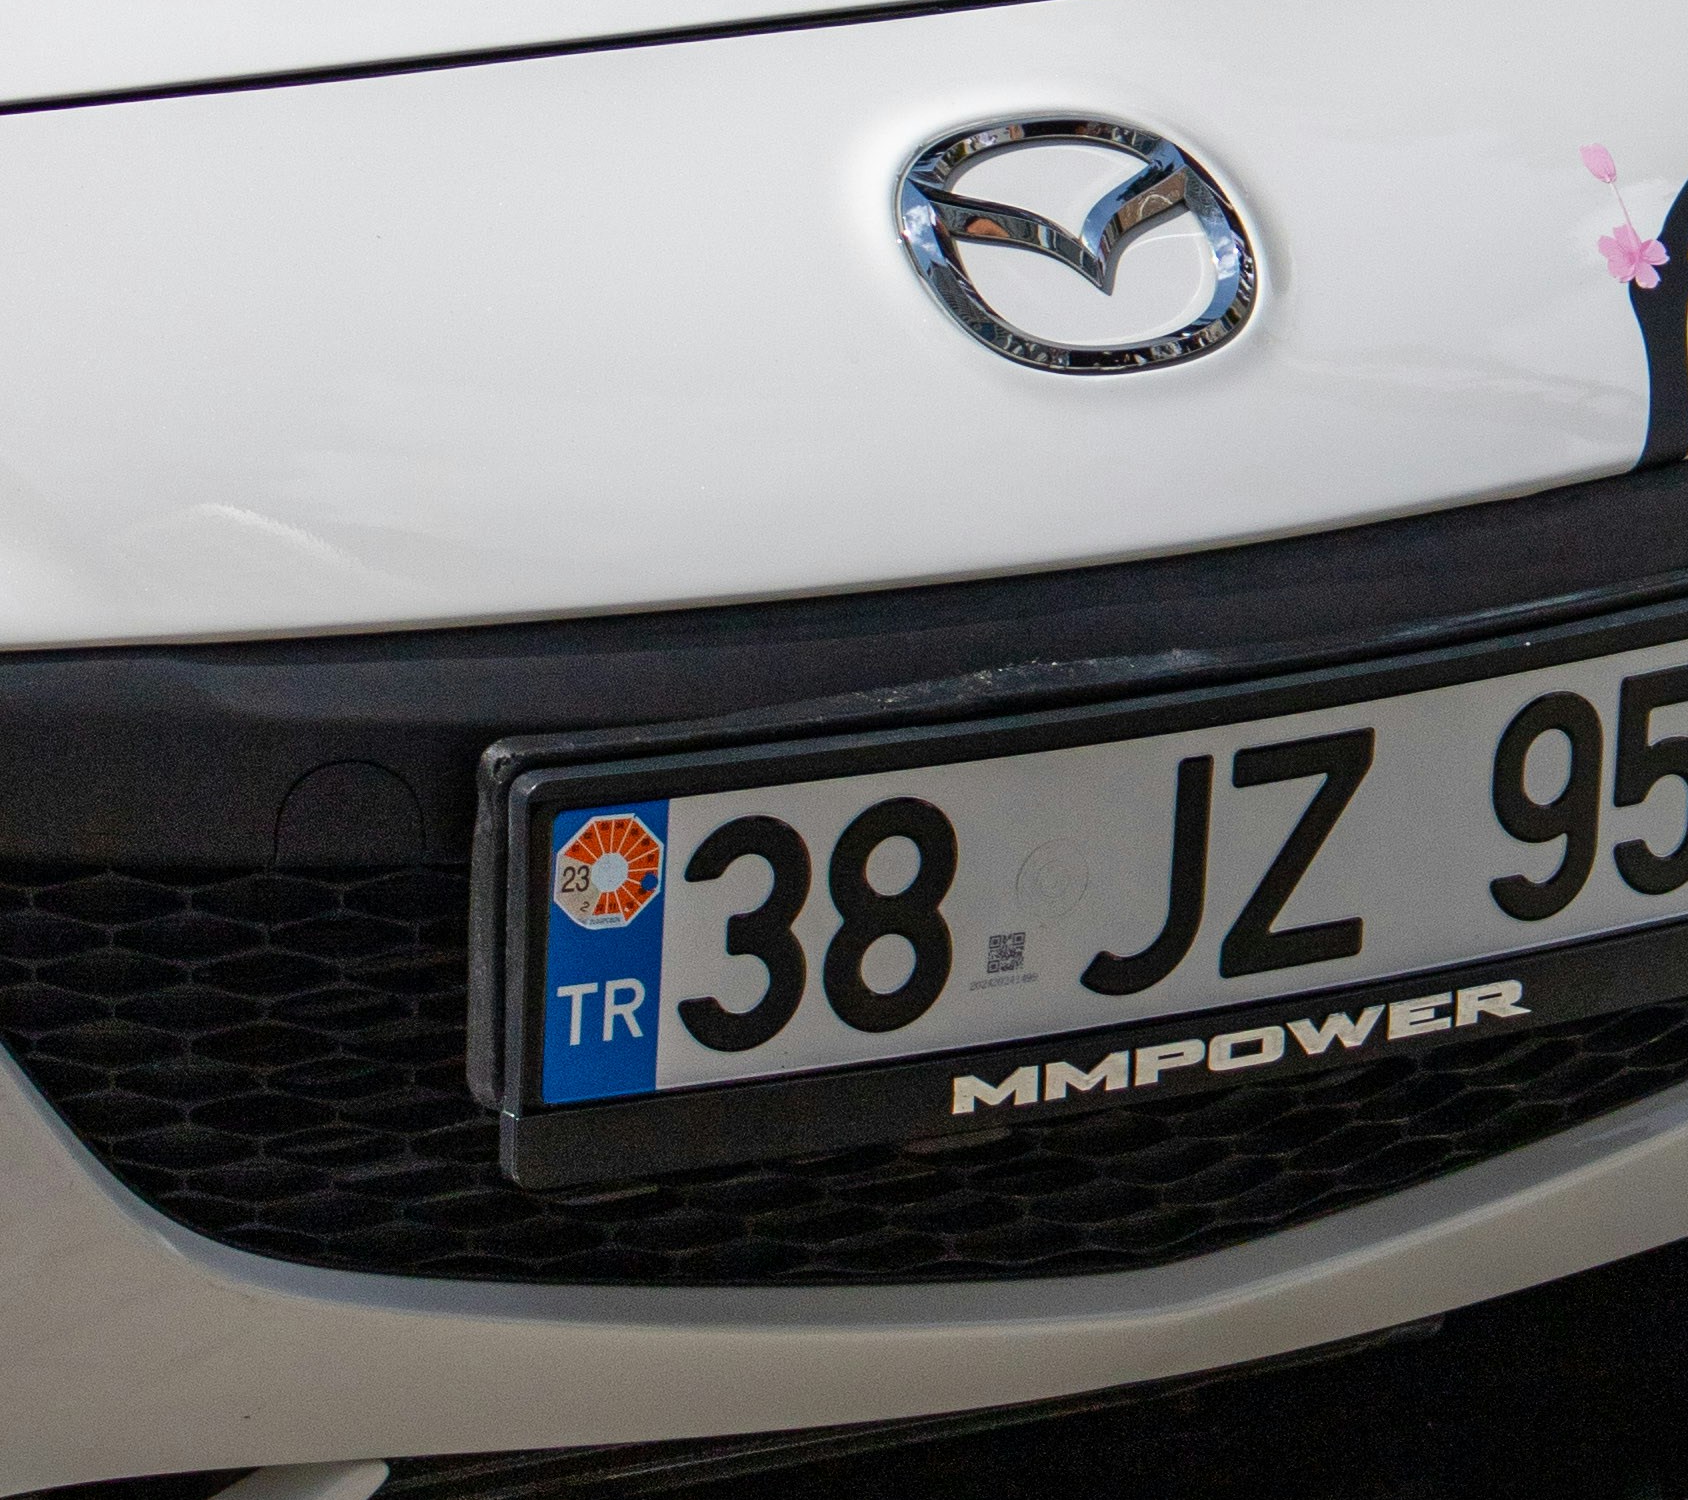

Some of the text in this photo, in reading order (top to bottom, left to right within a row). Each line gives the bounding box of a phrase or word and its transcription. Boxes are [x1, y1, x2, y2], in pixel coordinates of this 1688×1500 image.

[562, 864, 590, 893] 23
[678, 797, 957, 1052] 38
[1080, 728, 1374, 996] JZ
[556, 978, 646, 1046] TR
[952, 979, 1531, 1115] MMPOWER
